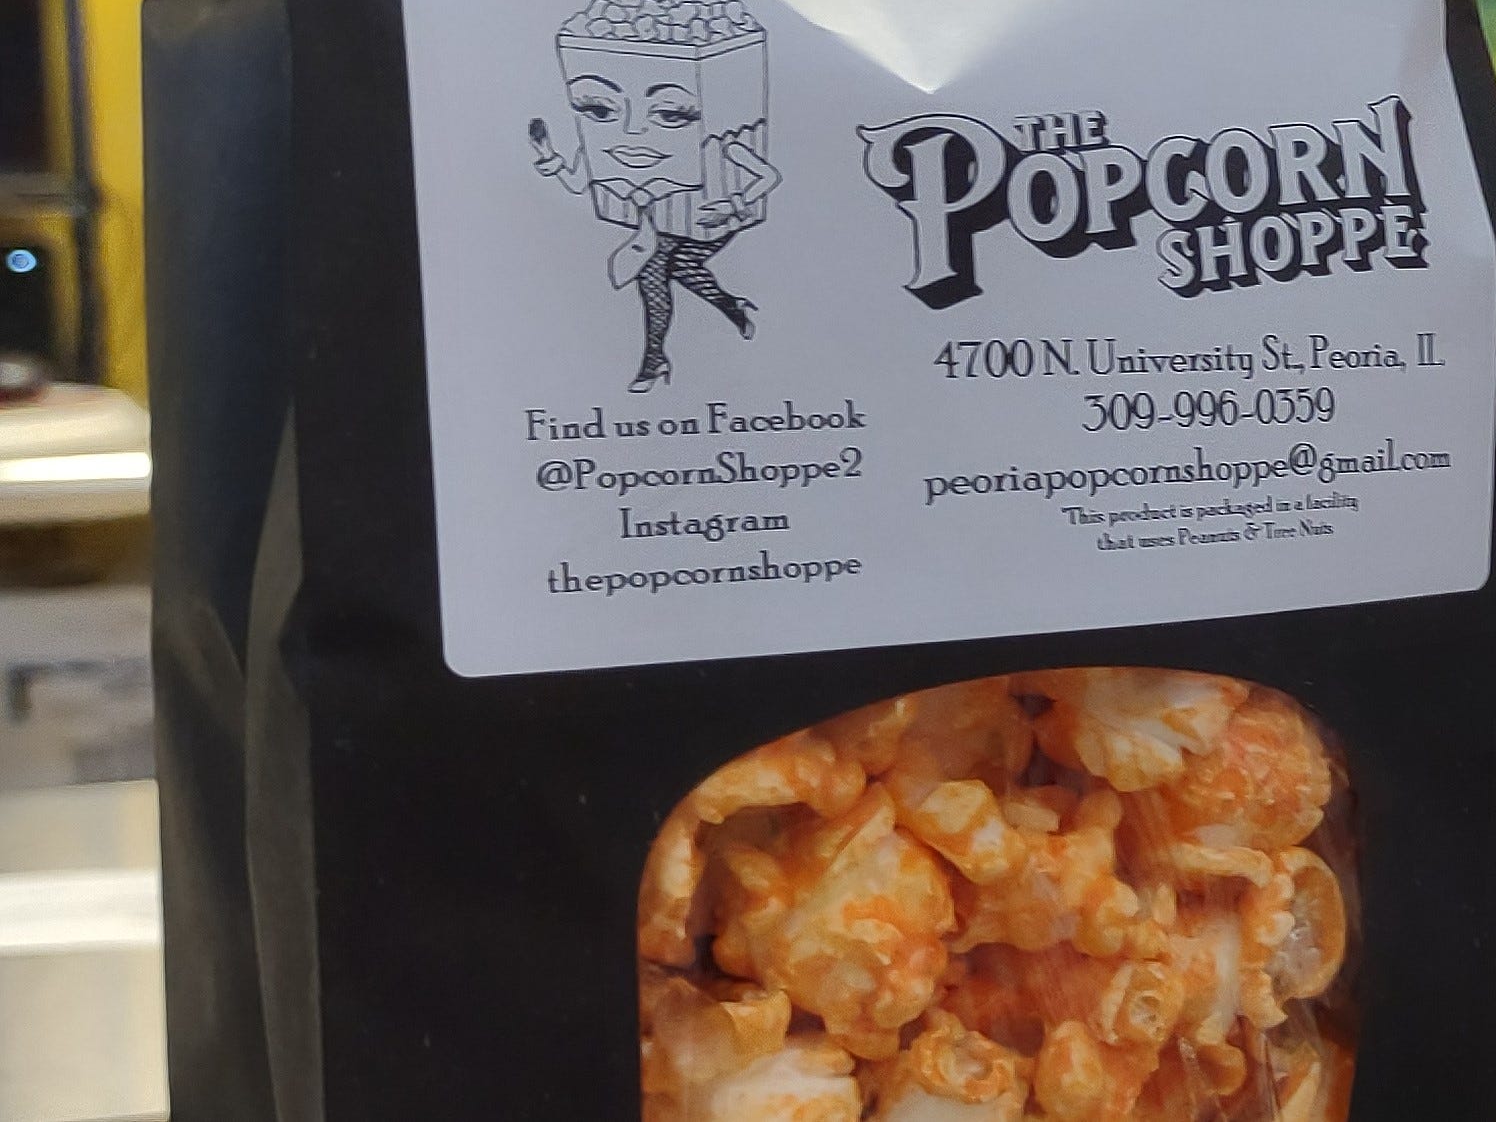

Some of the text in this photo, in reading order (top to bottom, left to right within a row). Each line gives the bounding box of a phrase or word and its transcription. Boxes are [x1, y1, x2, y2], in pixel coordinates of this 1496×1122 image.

[1013, 110, 1108, 153] THE
[856, 95, 1428, 310] POPCORN
[1156, 203, 1430, 298] SHOPPE
[933, 338, 1035, 379] 4700
[1041, 339, 1080, 376] N.
[1087, 338, 1255, 379] University
[1308, 333, 1407, 372] Peoria,
[525, 399, 867, 441] Find us on Facebook
[1081, 386, 1337, 432] 309-996-0359
[536, 446, 864, 496] @PopcornShoppe2
[924, 439, 1452, 505] peoriapopcornshoppe@gmail.com
[619, 507, 790, 542] Instagram
[1062, 505, 1106, 526] This
[1197, 495, 1274, 521] packaged
[1097, 531, 1135, 552] that
[1243, 522, 1262, 541] &
[547, 549, 864, 597] thepopcornshoppe
